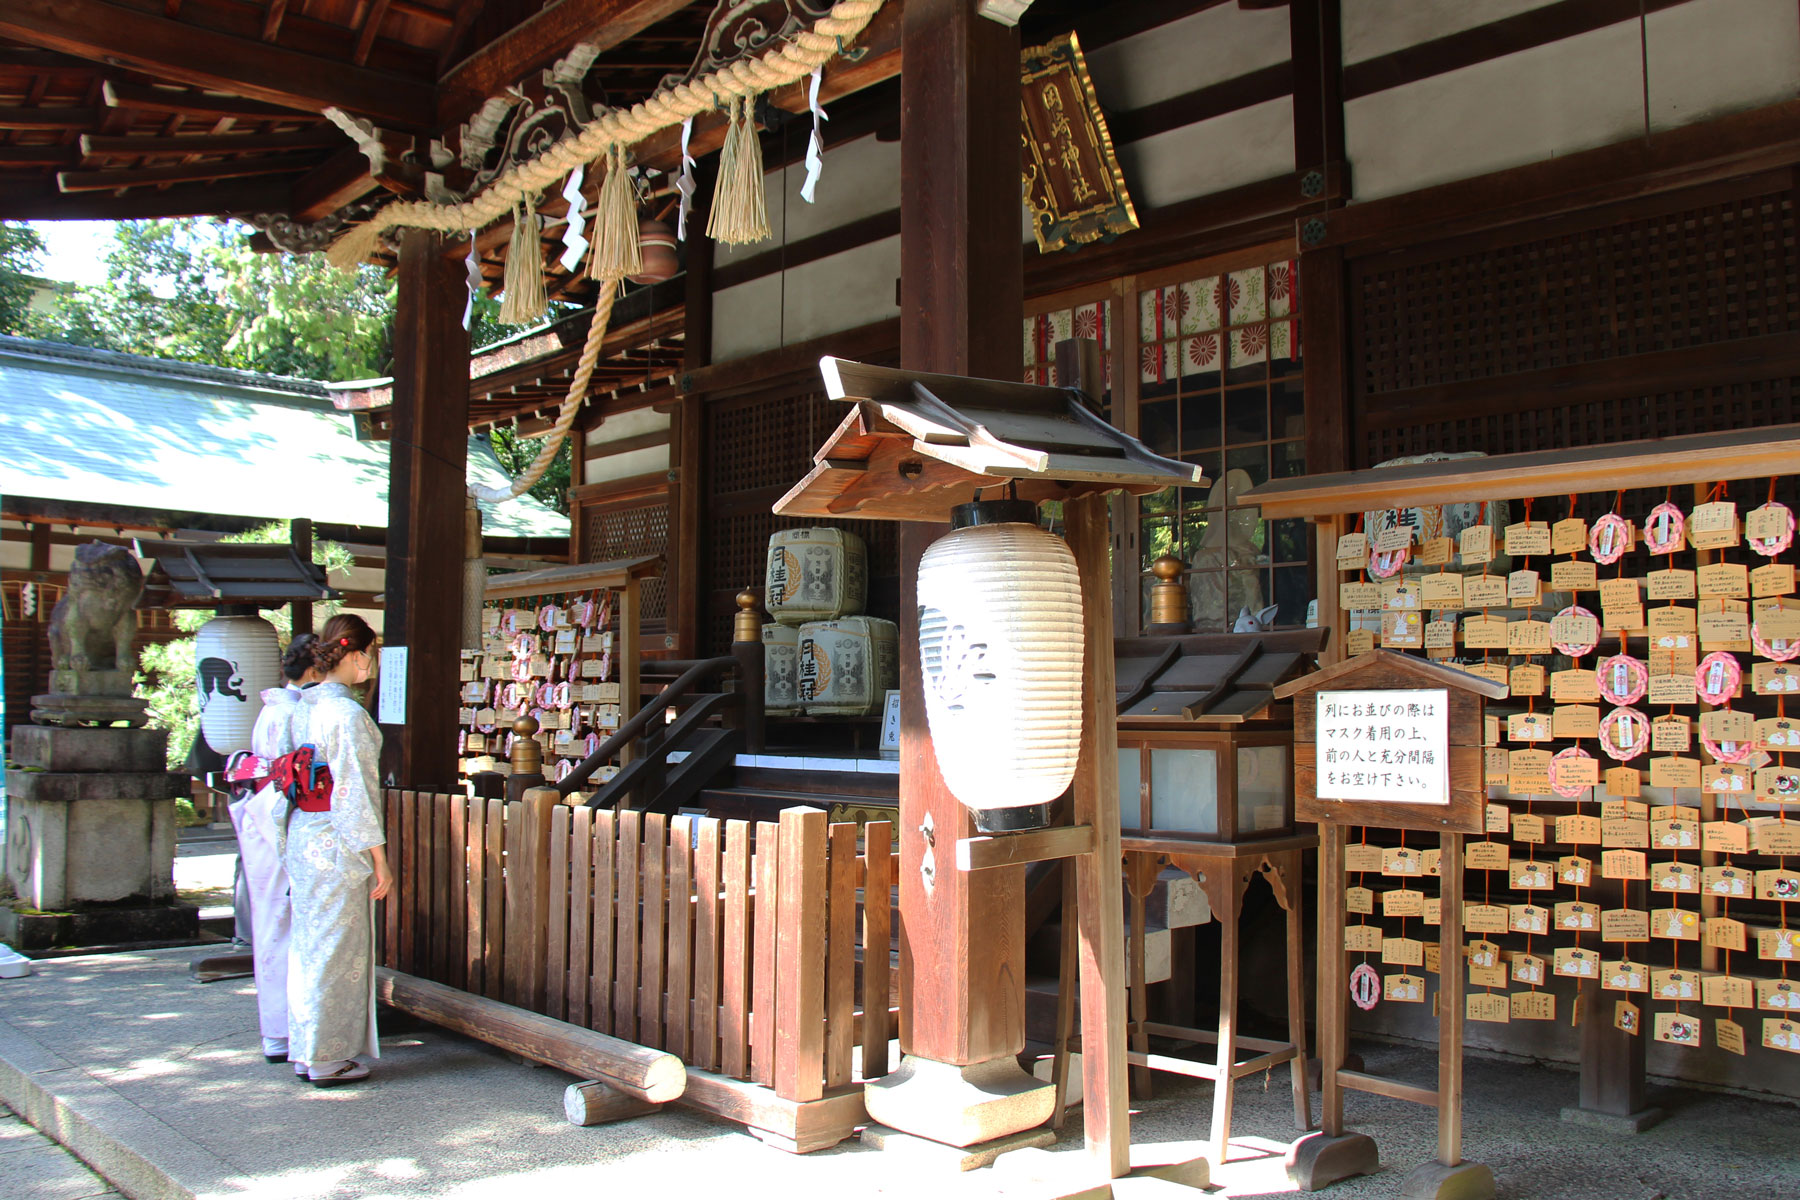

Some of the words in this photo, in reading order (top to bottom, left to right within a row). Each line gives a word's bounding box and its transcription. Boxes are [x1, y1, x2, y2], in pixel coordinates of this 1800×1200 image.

[769, 545, 787, 607] 月桂冠
[797, 638, 817, 701] 月桂冠
[1324, 702, 1435, 718] 列にお並びの際は
[1325, 725, 1428, 742] マスク着用の上、
[1325, 748, 1435, 765] 前の人と充分間隔
[1327, 771, 1427, 789] をお空け下さい。
